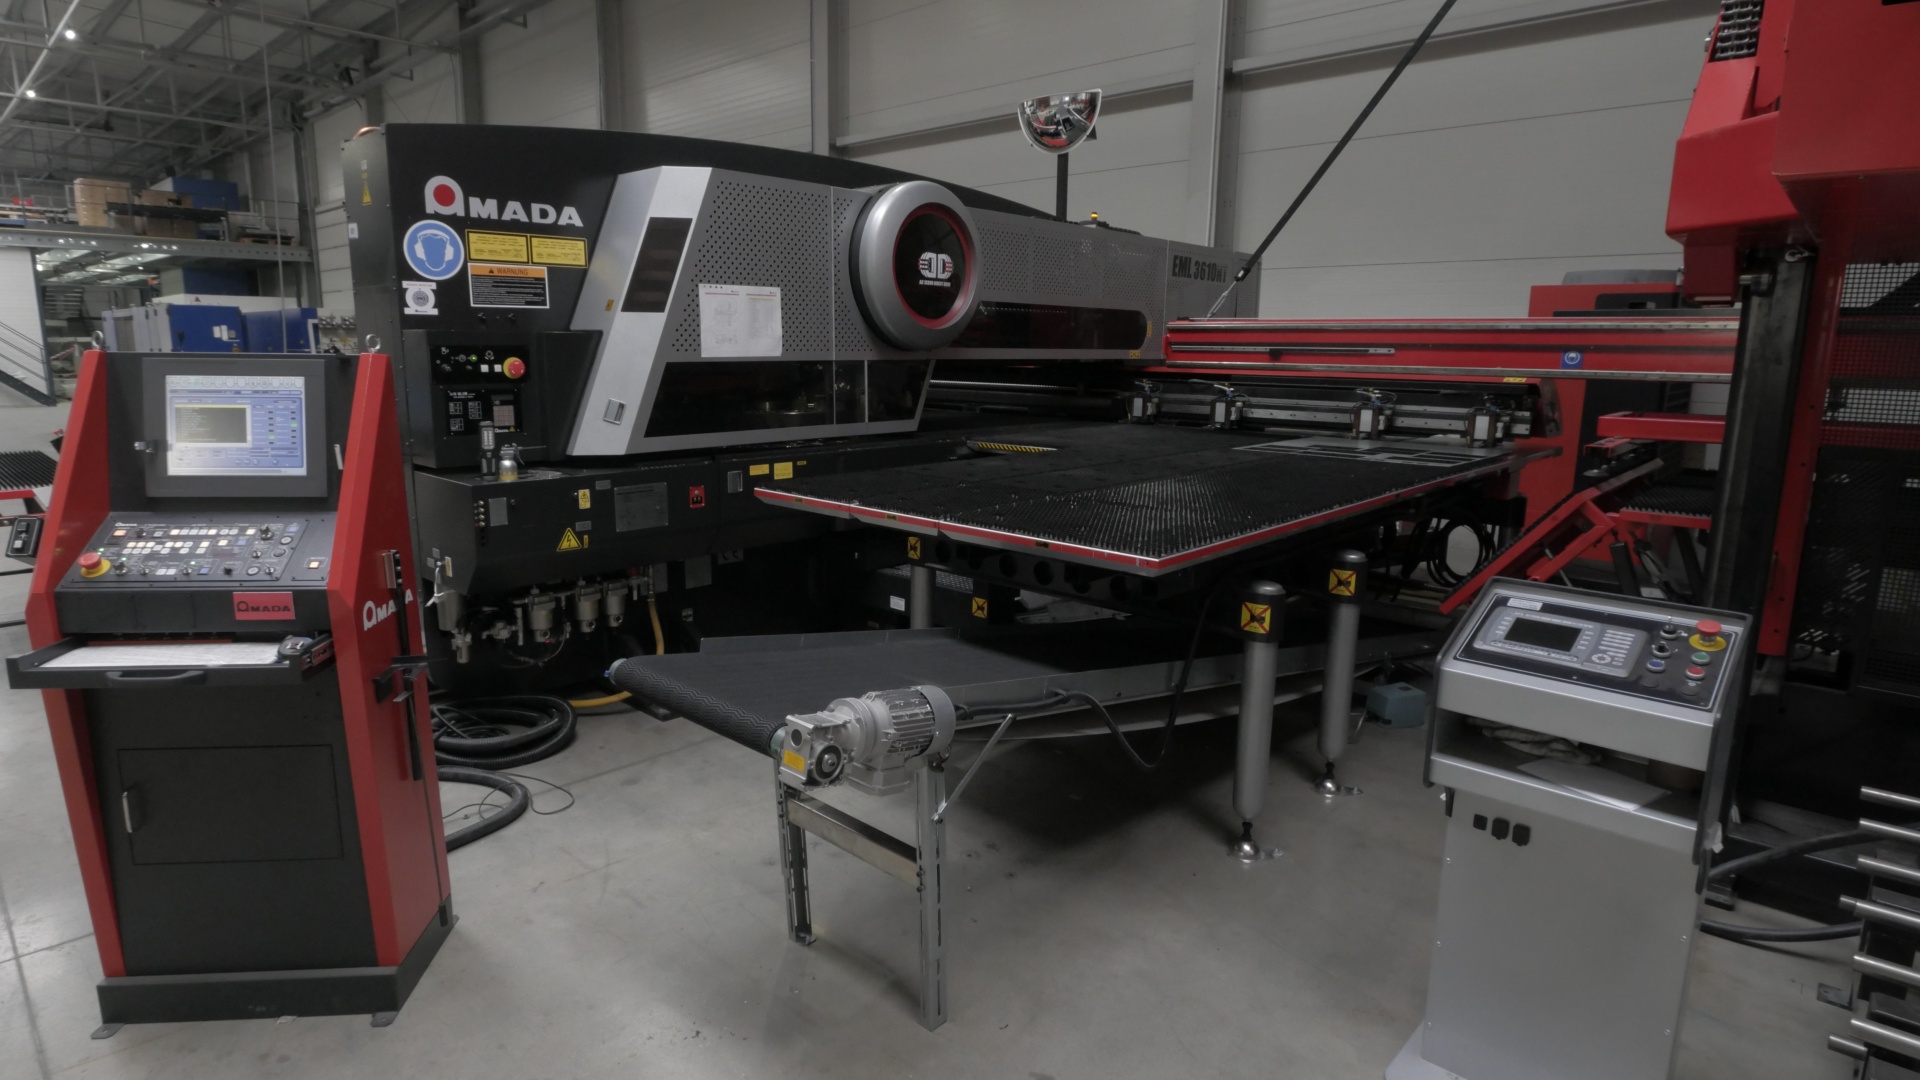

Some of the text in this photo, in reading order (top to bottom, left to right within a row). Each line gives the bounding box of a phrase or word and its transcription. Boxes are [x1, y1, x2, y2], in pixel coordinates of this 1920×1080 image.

[424, 175, 584, 227] AMADA
[1172, 255, 1192, 279] EML
[236, 600, 291, 612] AMADA
[363, 588, 413, 631] AMAA
